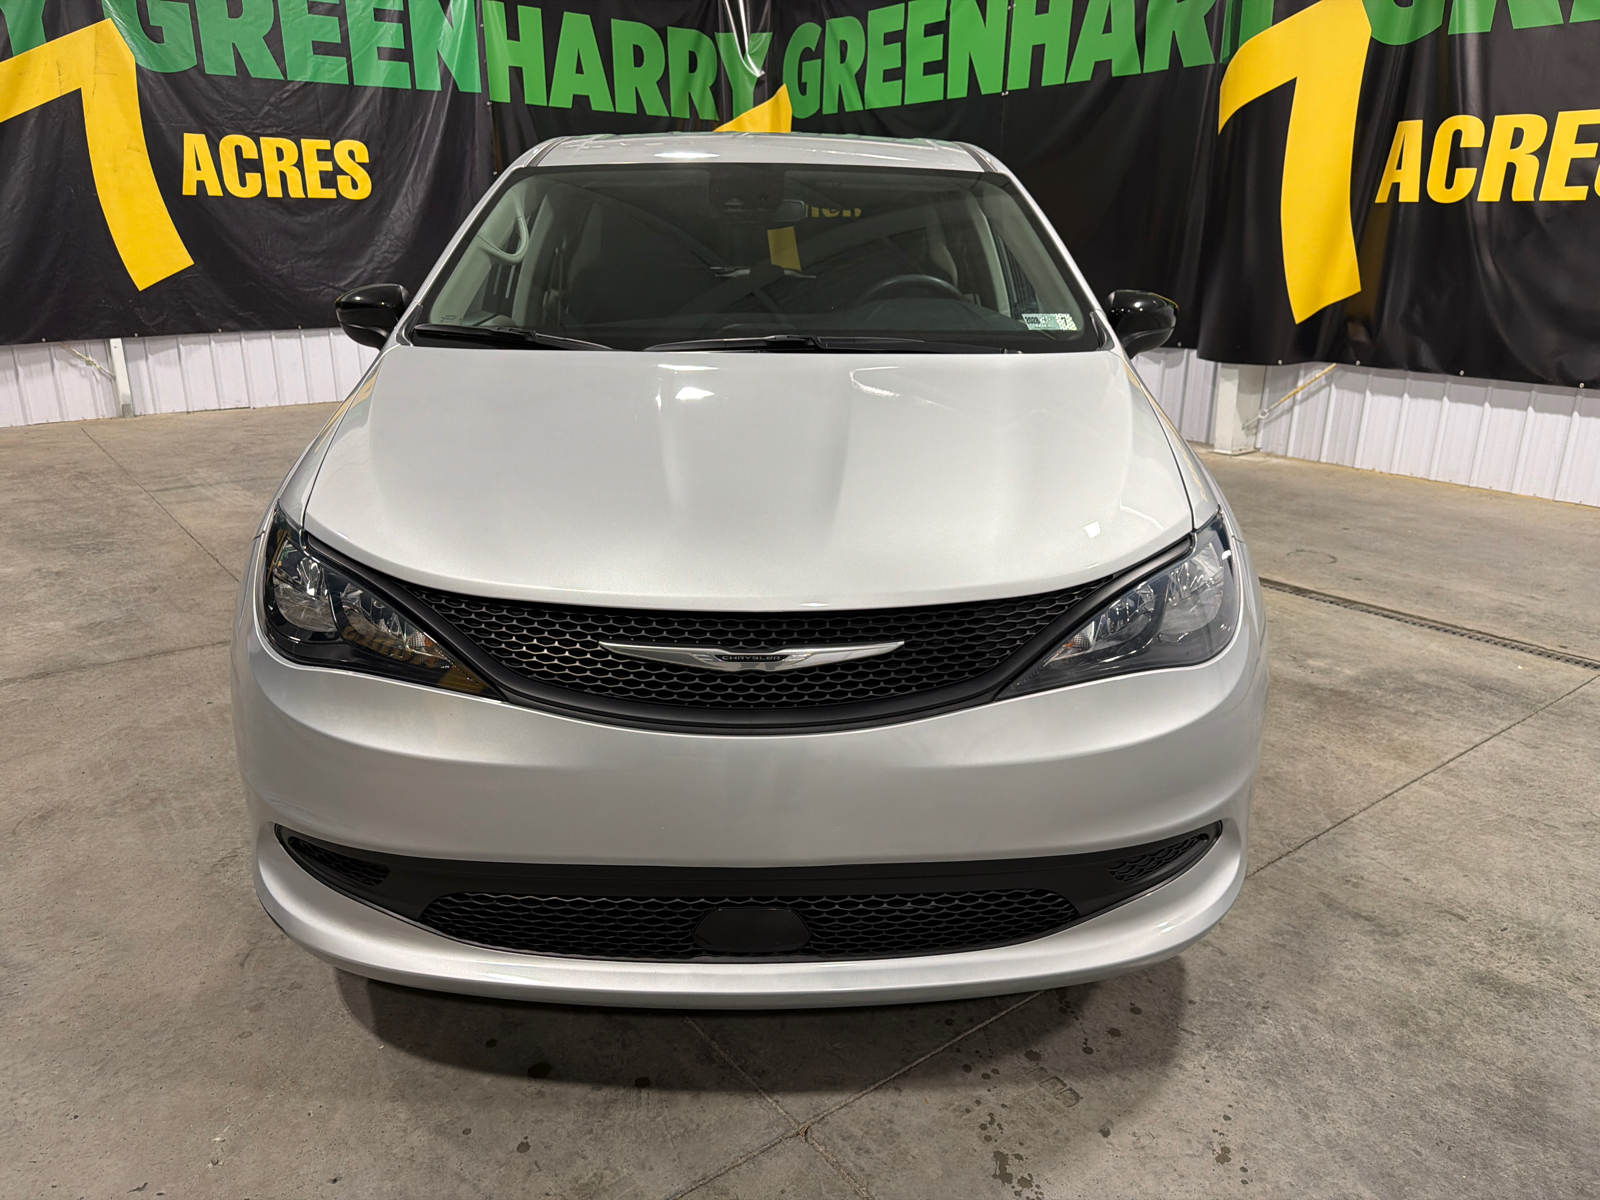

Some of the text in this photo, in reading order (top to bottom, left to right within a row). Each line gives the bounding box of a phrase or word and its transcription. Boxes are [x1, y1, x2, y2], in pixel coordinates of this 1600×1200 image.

[102, 0, 482, 93] GREEN
[482, 0, 773, 121] HARRY
[783, 0, 1007, 119] GREEN
[182, 132, 373, 200] ACRES
[1375, 108, 1600, 204] ACRE
